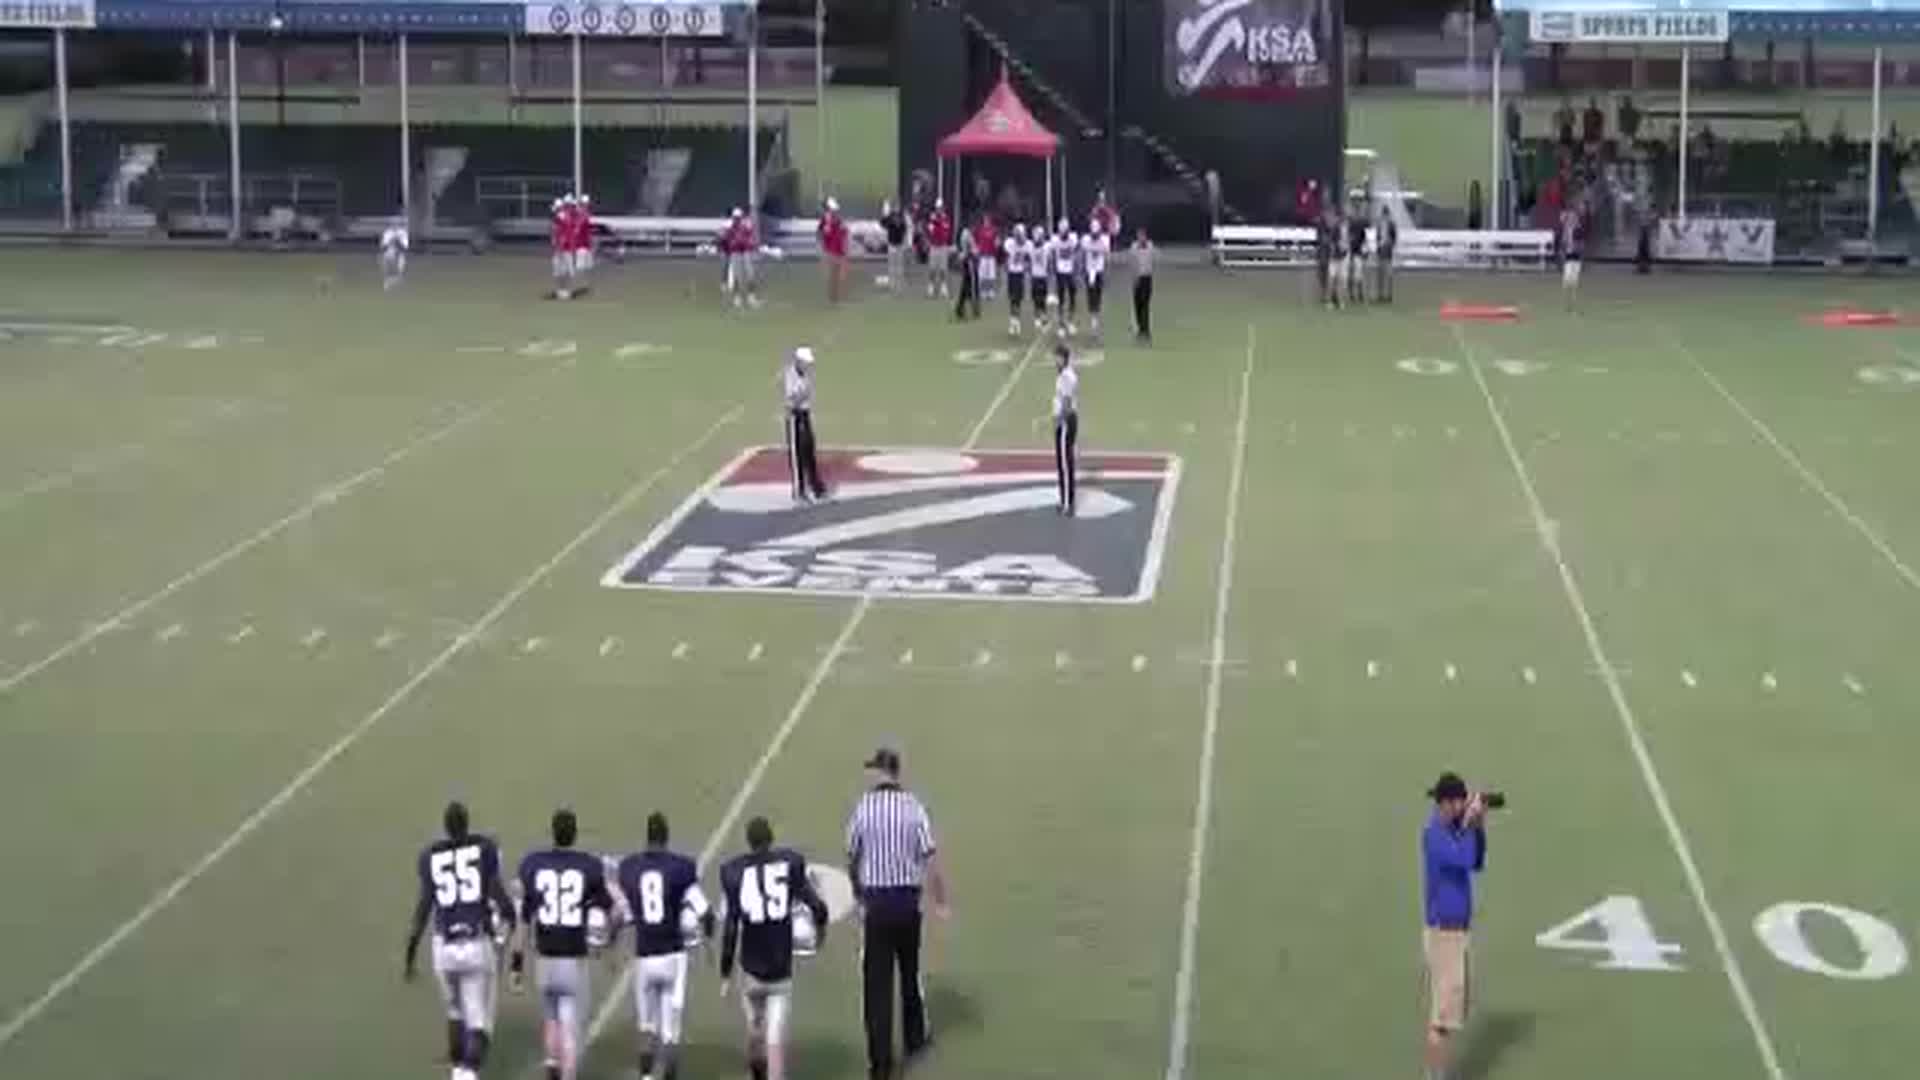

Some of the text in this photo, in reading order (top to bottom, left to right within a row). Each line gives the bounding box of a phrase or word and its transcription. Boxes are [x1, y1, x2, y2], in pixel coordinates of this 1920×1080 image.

[1247, 26, 1315, 51] KSA
[430, 846, 483, 905] 55
[535, 869, 584, 926] 32
[641, 871, 665, 924] 8
[740, 863, 790, 923] 45
